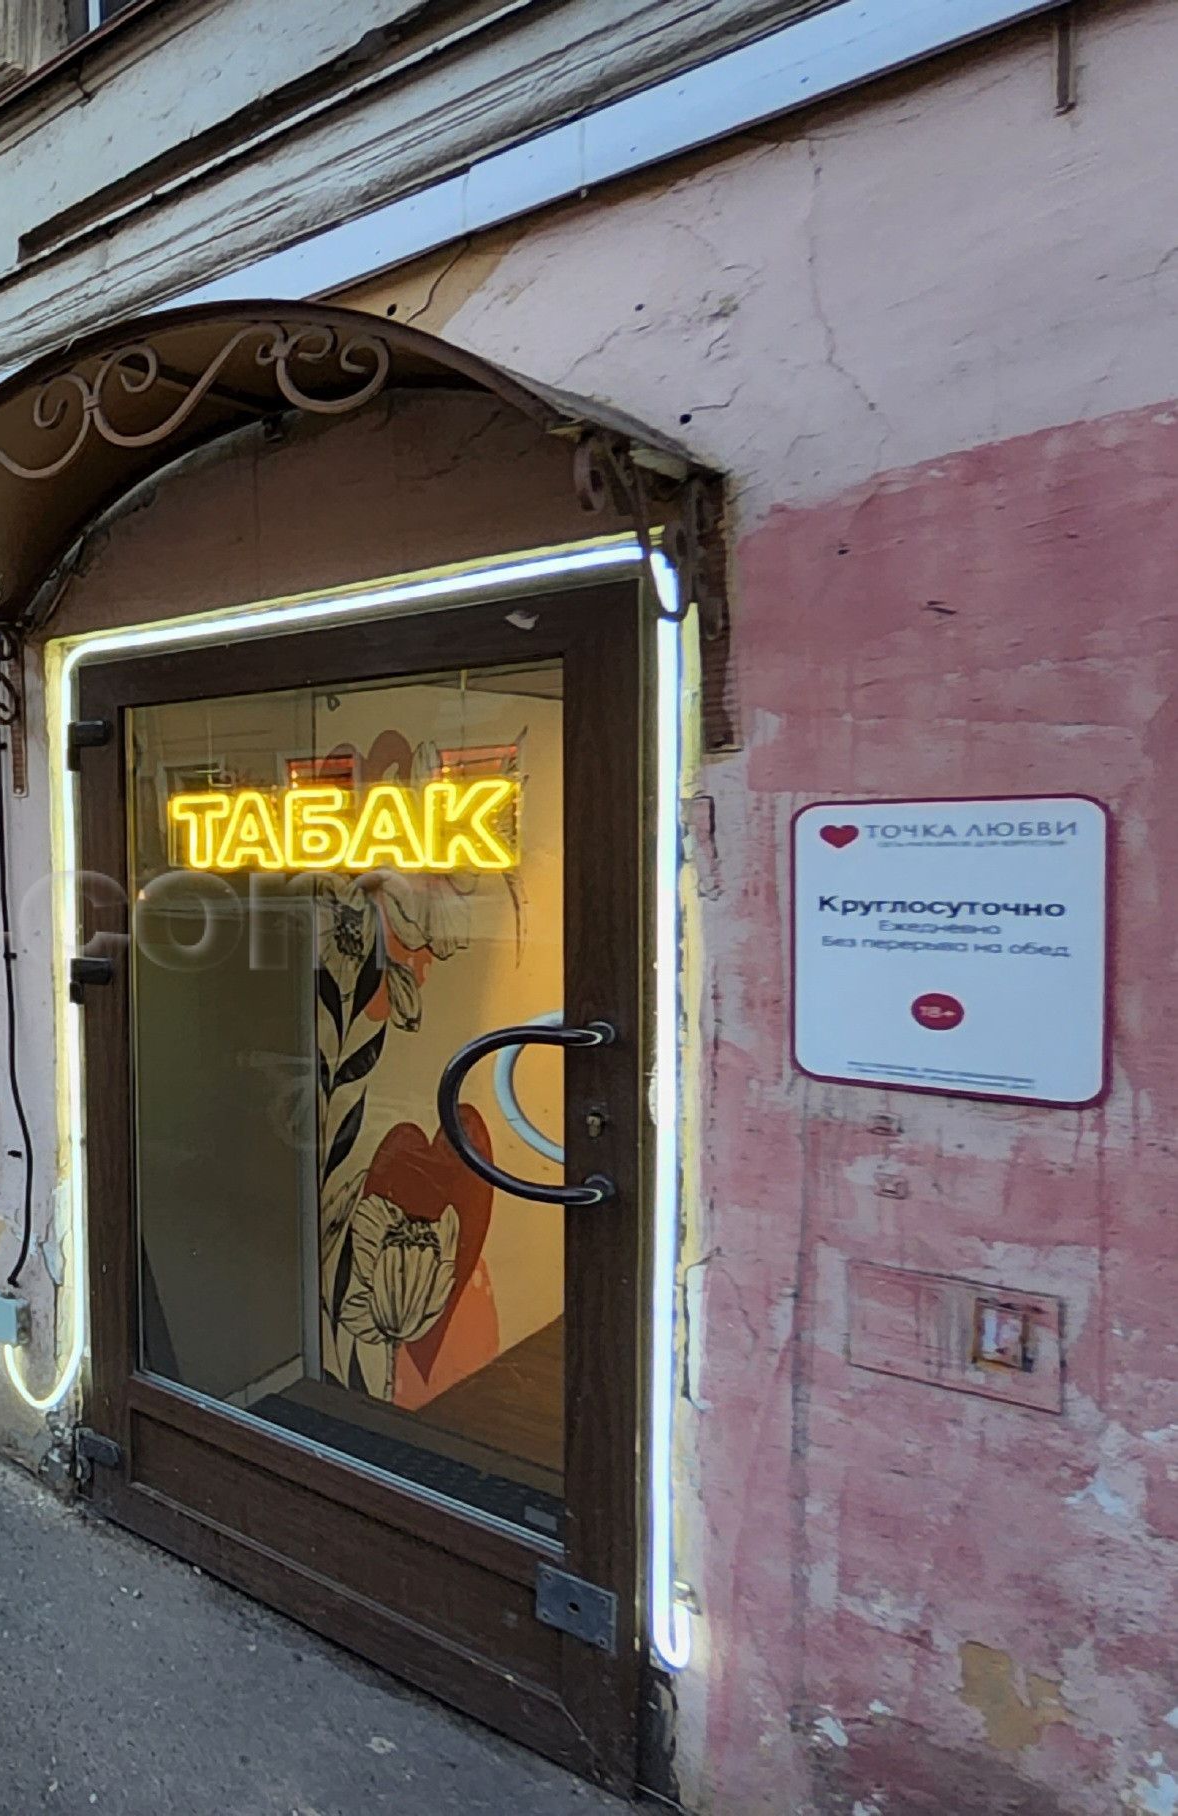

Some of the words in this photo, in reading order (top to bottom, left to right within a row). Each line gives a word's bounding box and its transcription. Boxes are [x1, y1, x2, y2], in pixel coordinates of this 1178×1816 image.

[168, 777, 517, 869] ТАБАК
[865, 823, 957, 839] ТОЧКА
[965, 820, 1077, 838] ЛЮБВИ
[818, 895, 1066, 919] Круглосуточно
